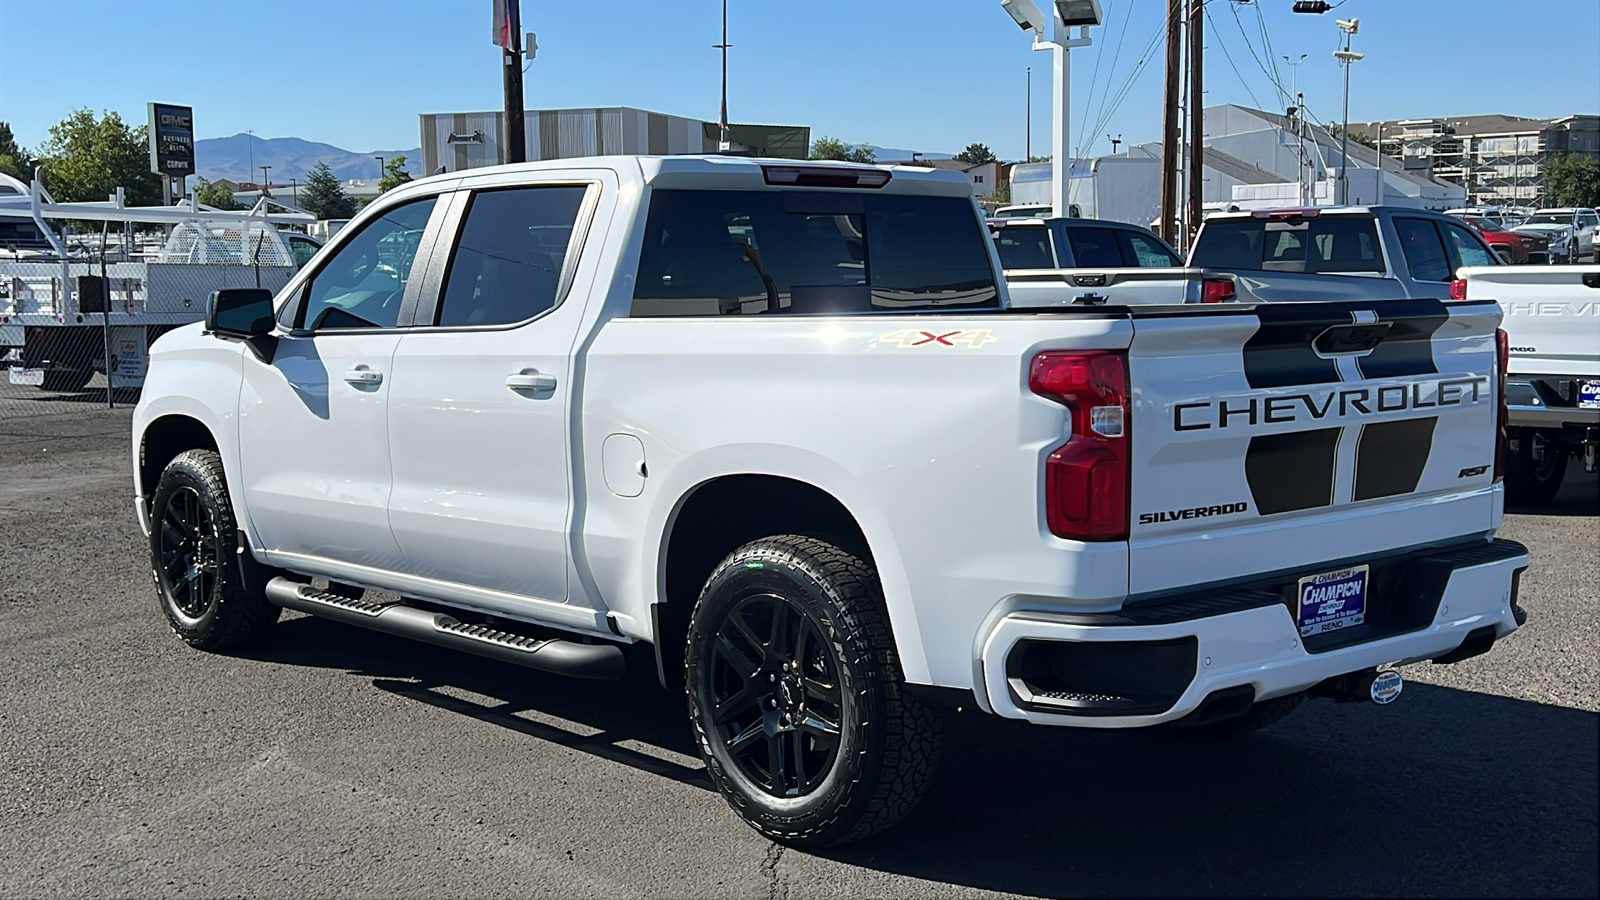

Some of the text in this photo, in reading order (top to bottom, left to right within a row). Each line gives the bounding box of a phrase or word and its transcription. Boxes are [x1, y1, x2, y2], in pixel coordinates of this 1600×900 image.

[161, 114, 191, 127] GMC
[162, 135, 190, 144] BUSINESS
[166, 160, 189, 169] CORWIN
[1174, 377, 1487, 432] CHEVROLET
[1458, 464, 1492, 479] RST
[1139, 502, 1248, 524] SILVERADO
[1318, 570, 1351, 583] CHAMPION
[1302, 580, 1362, 606] CHAMPION
[1321, 620, 1344, 631] RENO
